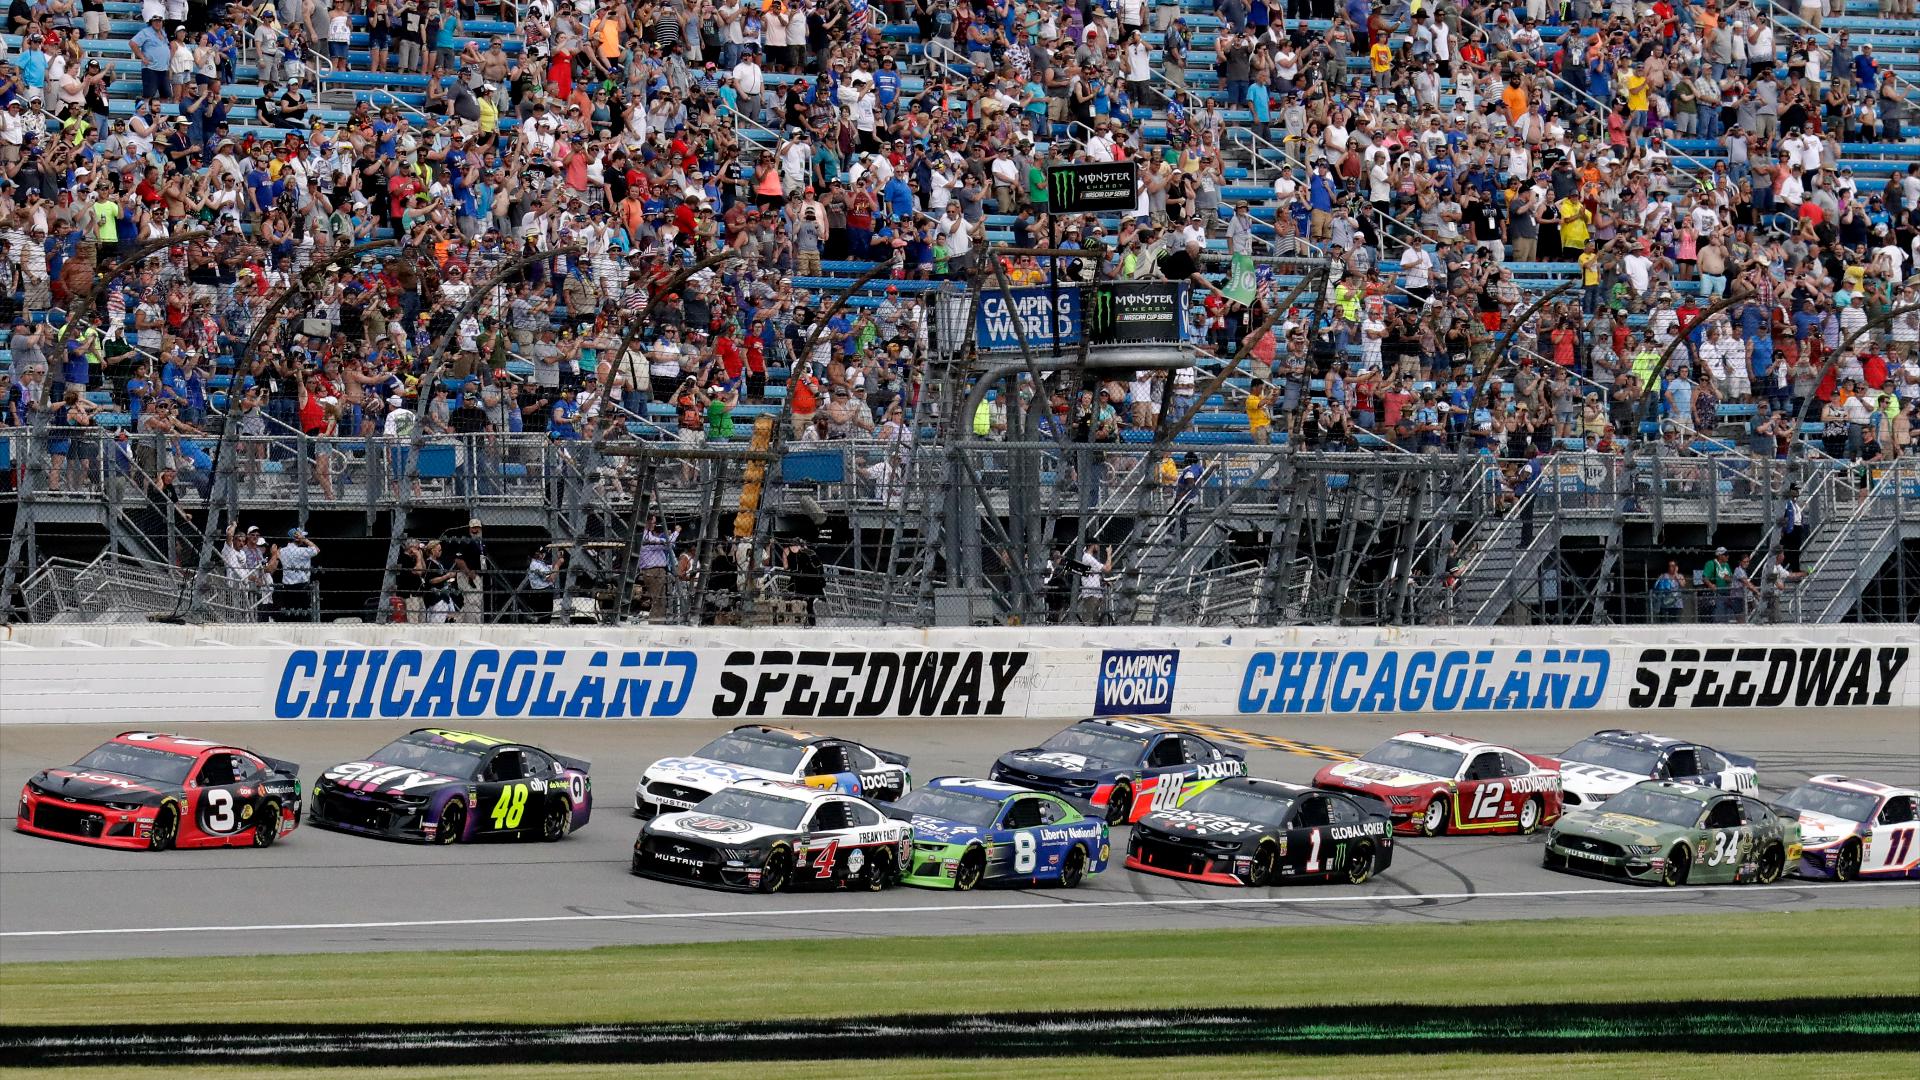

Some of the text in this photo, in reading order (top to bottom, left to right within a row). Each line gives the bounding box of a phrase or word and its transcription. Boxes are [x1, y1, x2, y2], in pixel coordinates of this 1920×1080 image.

[1079, 171, 1130, 185] MONSTER
[1085, 190, 1104, 198] NASCAR
[1114, 189, 1130, 197] SERIES
[1115, 293, 1174, 306] MONSTER
[1123, 313, 1146, 321] NASCAR
[1104, 654, 1172, 678] CAMPING
[274, 649, 698, 718] CHICAGOLAND
[711, 650, 1029, 716] SPEEDWAY
[1237, 649, 1610, 713] CHICAGOLAND
[1628, 647, 1909, 708] SPEEDWAY
[1197, 760, 1241, 780] AXALTA
[530, 777, 549, 795] ally
[859, 773, 888, 791] toco
[1151, 772, 1184, 812] 88
[1508, 776, 1559, 793] BODYARMOR
[207, 789, 235, 831] 3
[490, 783, 529, 829] 48
[655, 797, 695, 809] MUSTAN
[1467, 782, 1505, 819] 12
[858, 829, 898, 843] FREAKY FAST!
[1040, 825, 1096, 843] Liberty National
[1330, 822, 1385, 840] GLOBAL POKER
[1014, 831, 1036, 873] 8
[1306, 826, 1321, 872] 1
[1564, 848, 1609, 863] MUSTANG
[1707, 830, 1740, 867] 34
[1883, 827, 1915, 866] 11
[655, 852, 704, 868] MUSTANG
[812, 838, 840, 879] 4
